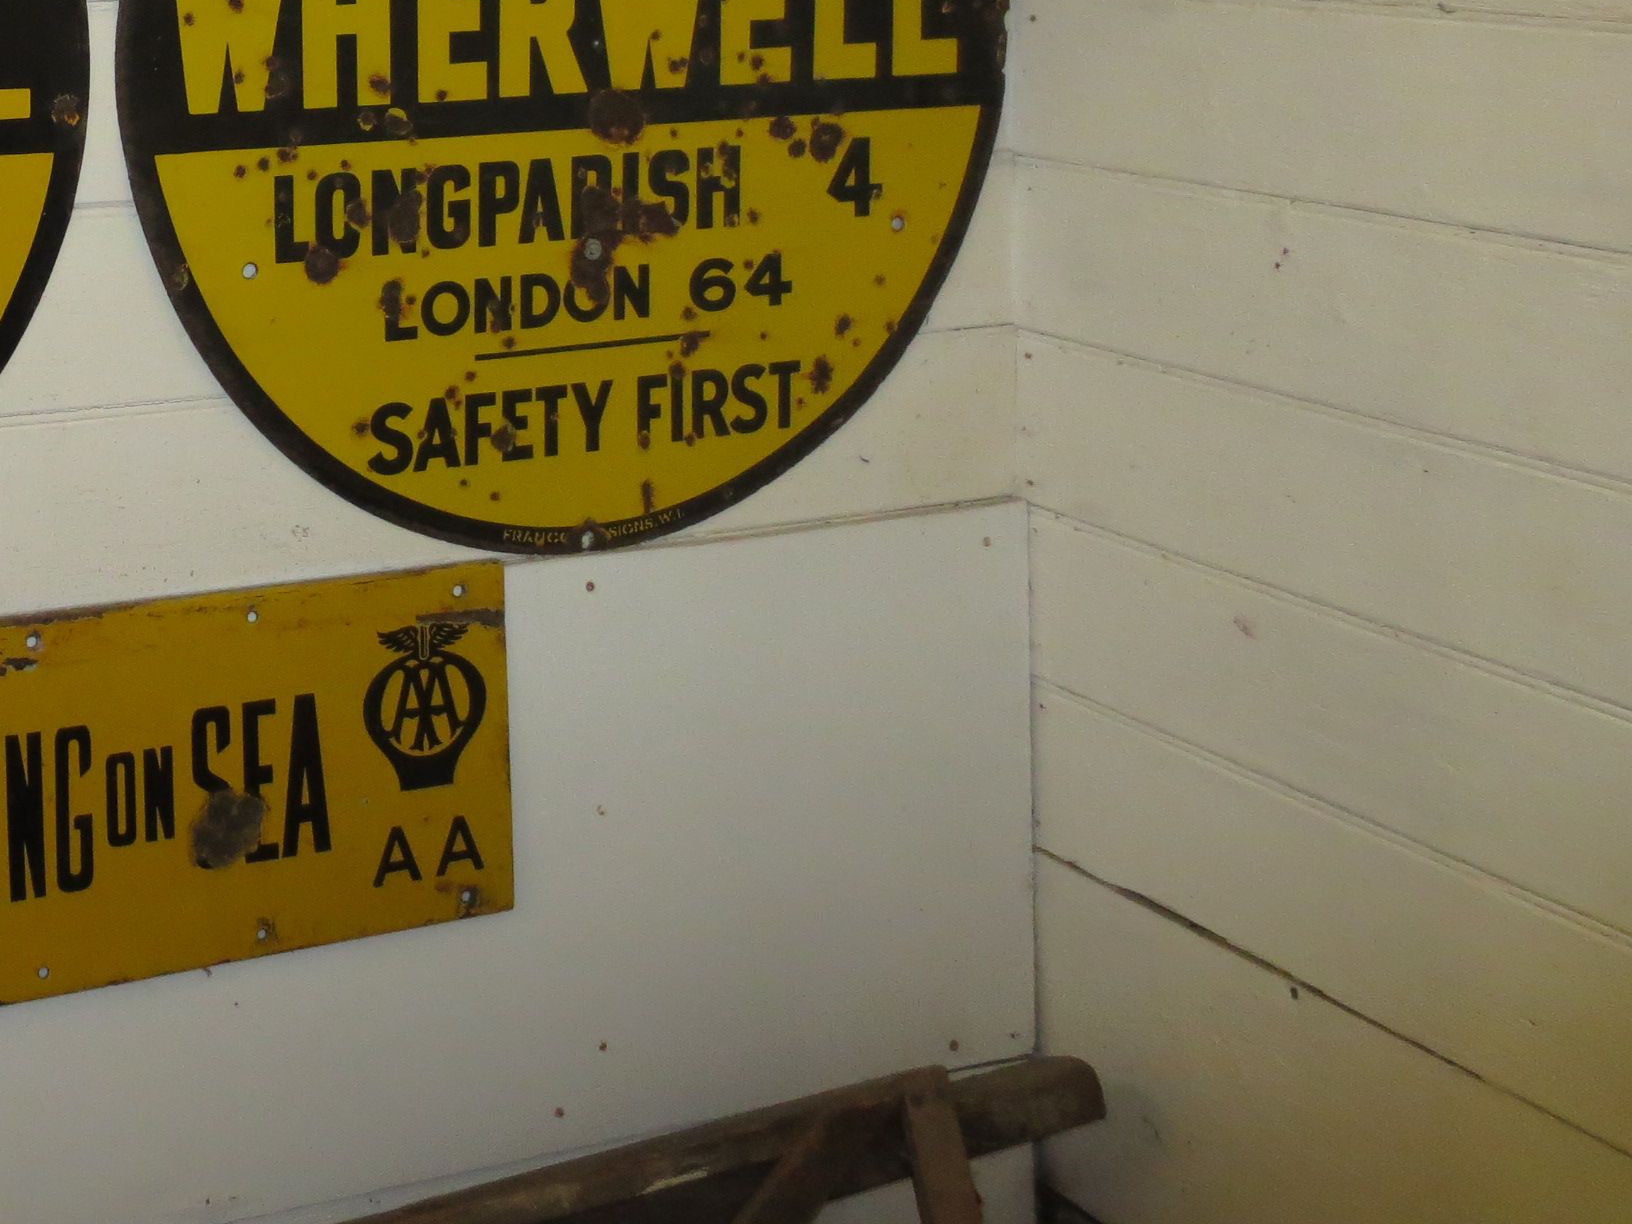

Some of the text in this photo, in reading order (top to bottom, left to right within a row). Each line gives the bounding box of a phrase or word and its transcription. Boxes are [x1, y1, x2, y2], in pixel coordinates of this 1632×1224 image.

[827, 137, 883, 217] 4
[383, 253, 792, 342] LONDON 64
[368, 360, 802, 476] SAFETY FIRST
[106, 745, 176, 849] ON
[190, 693, 331, 870] SEA
